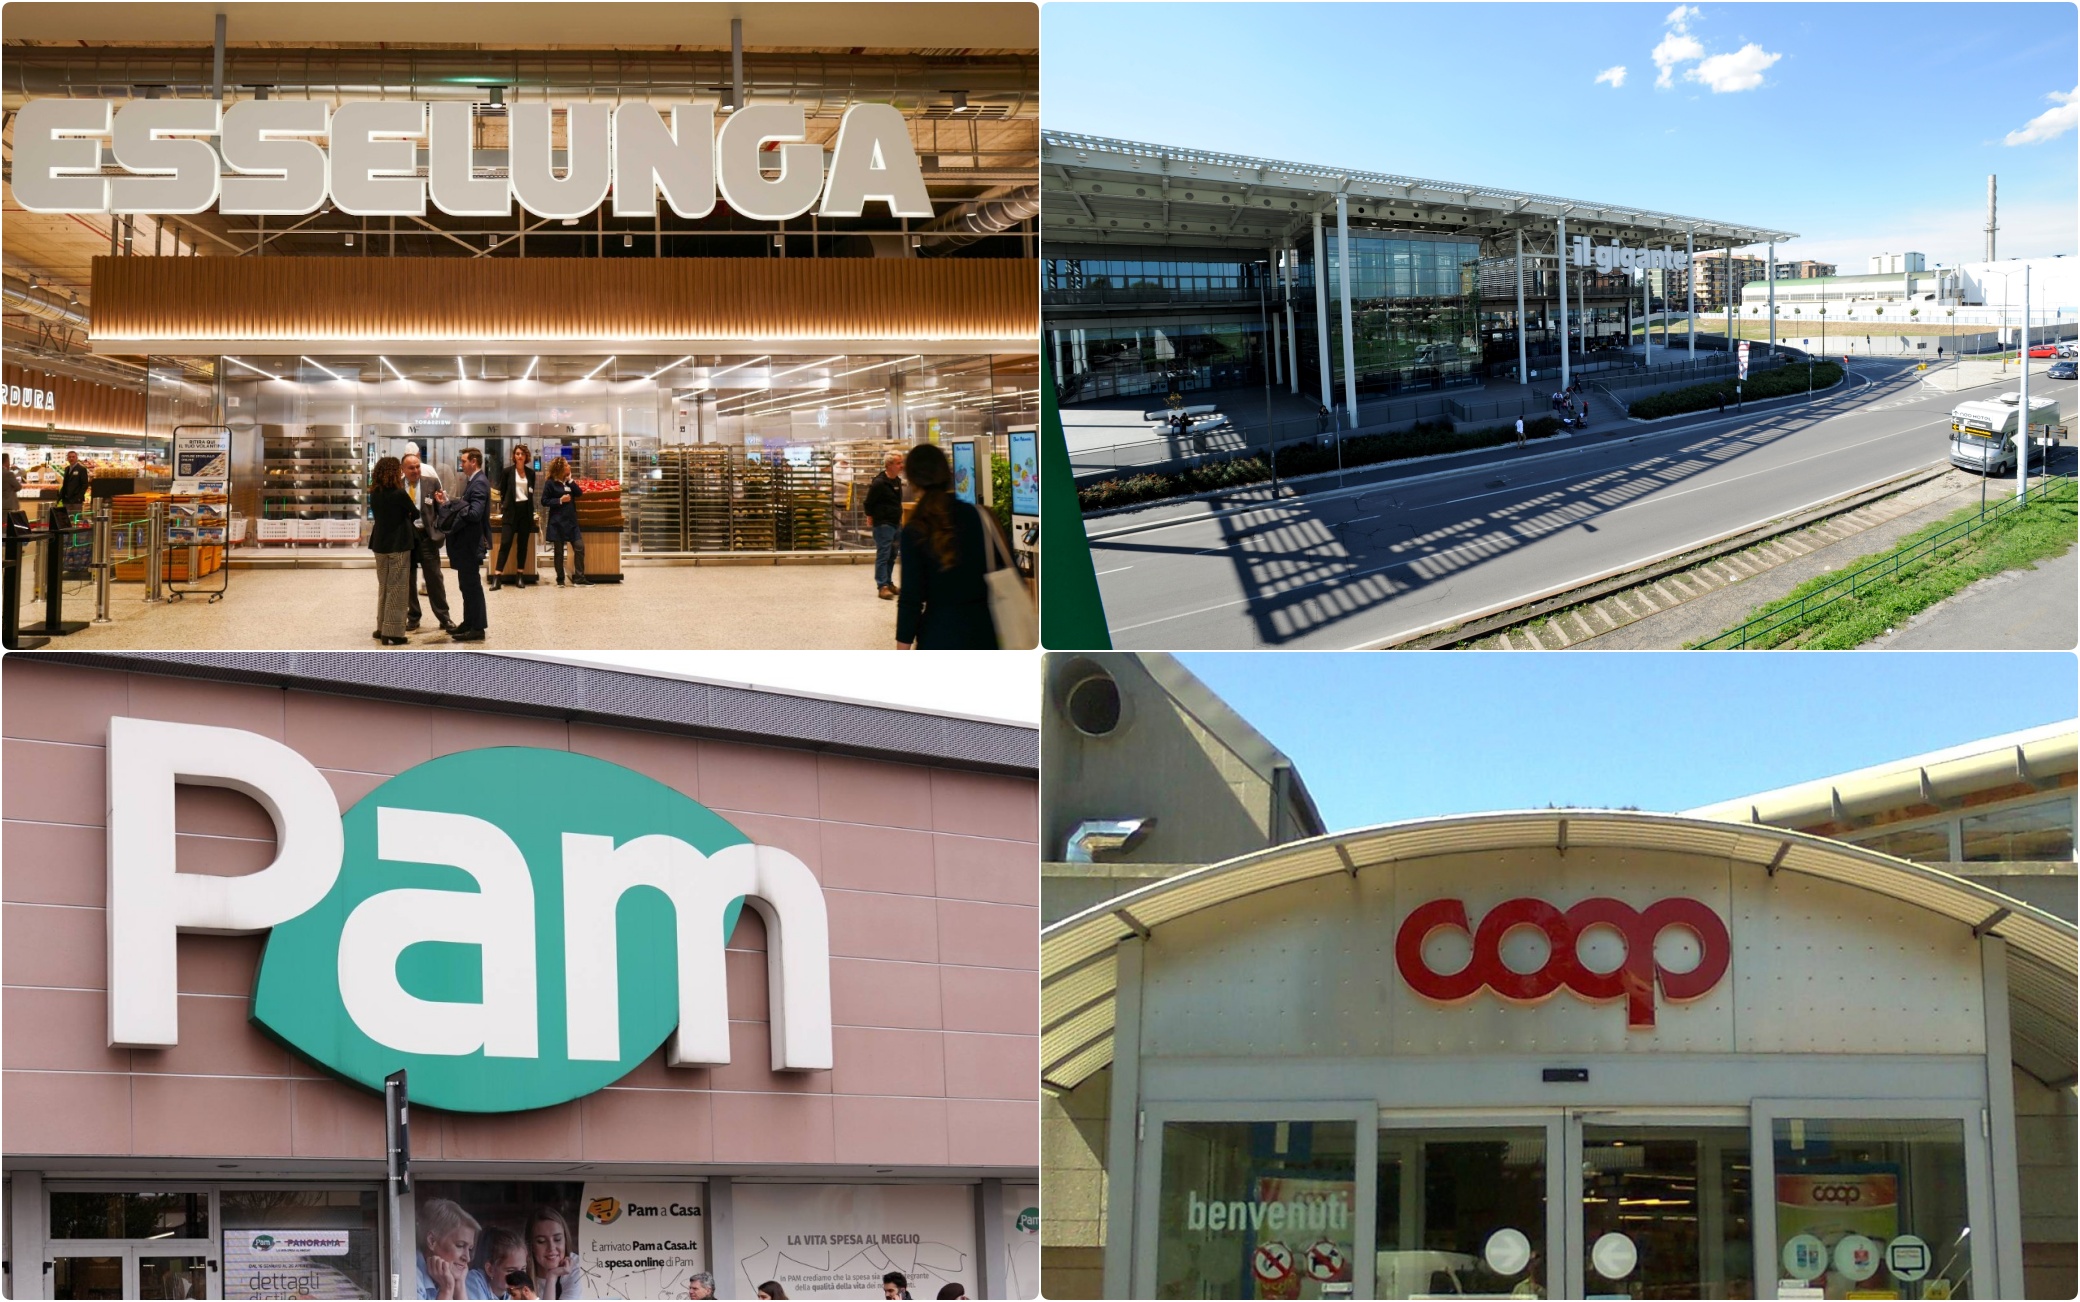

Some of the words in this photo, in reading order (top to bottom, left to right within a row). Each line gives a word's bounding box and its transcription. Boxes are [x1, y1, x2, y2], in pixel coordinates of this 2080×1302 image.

[10, 98, 935, 221] ESSELUNGA
[1573, 236, 1591, 267] il
[1595, 238, 1688, 275] gigante
[107, 715, 833, 1073] Pam
[1394, 897, 1731, 1030] coop
[1812, 1186, 1861, 1206] coop
[628, 1203, 658, 1217] Pam
[660, 1207, 667, 1216] a
[670, 1203, 701, 1217] Casa
[1188, 1190, 1348, 1231] benvenuti
[287, 1239, 341, 1247] PANORAMA
[592, 1239, 598, 1252] È
[599, 1241, 631, 1251] arrivato
[632, 1241, 655, 1251] Pam
[664, 1240, 697, 1250] Casa.it
[787, 1235, 801, 1245] LA
[804, 1235, 827, 1245] VITA
[830, 1234, 863, 1245] SPESA
[866, 1234, 878, 1244] AL
[882, 1233, 920, 1244] MEGLIO
[596, 1257, 604, 1268] la
[605, 1260, 632, 1270] spesa
[634, 1257, 664, 1267] online
[666, 1256, 673, 1267] di
[675, 1257, 693, 1267] Pam
[249, 1271, 319, 1295] dettagli
[853, 1274, 870, 1282] spesa
[906, 1273, 929, 1281] tegrante
[812, 1283, 834, 1292] qualità
